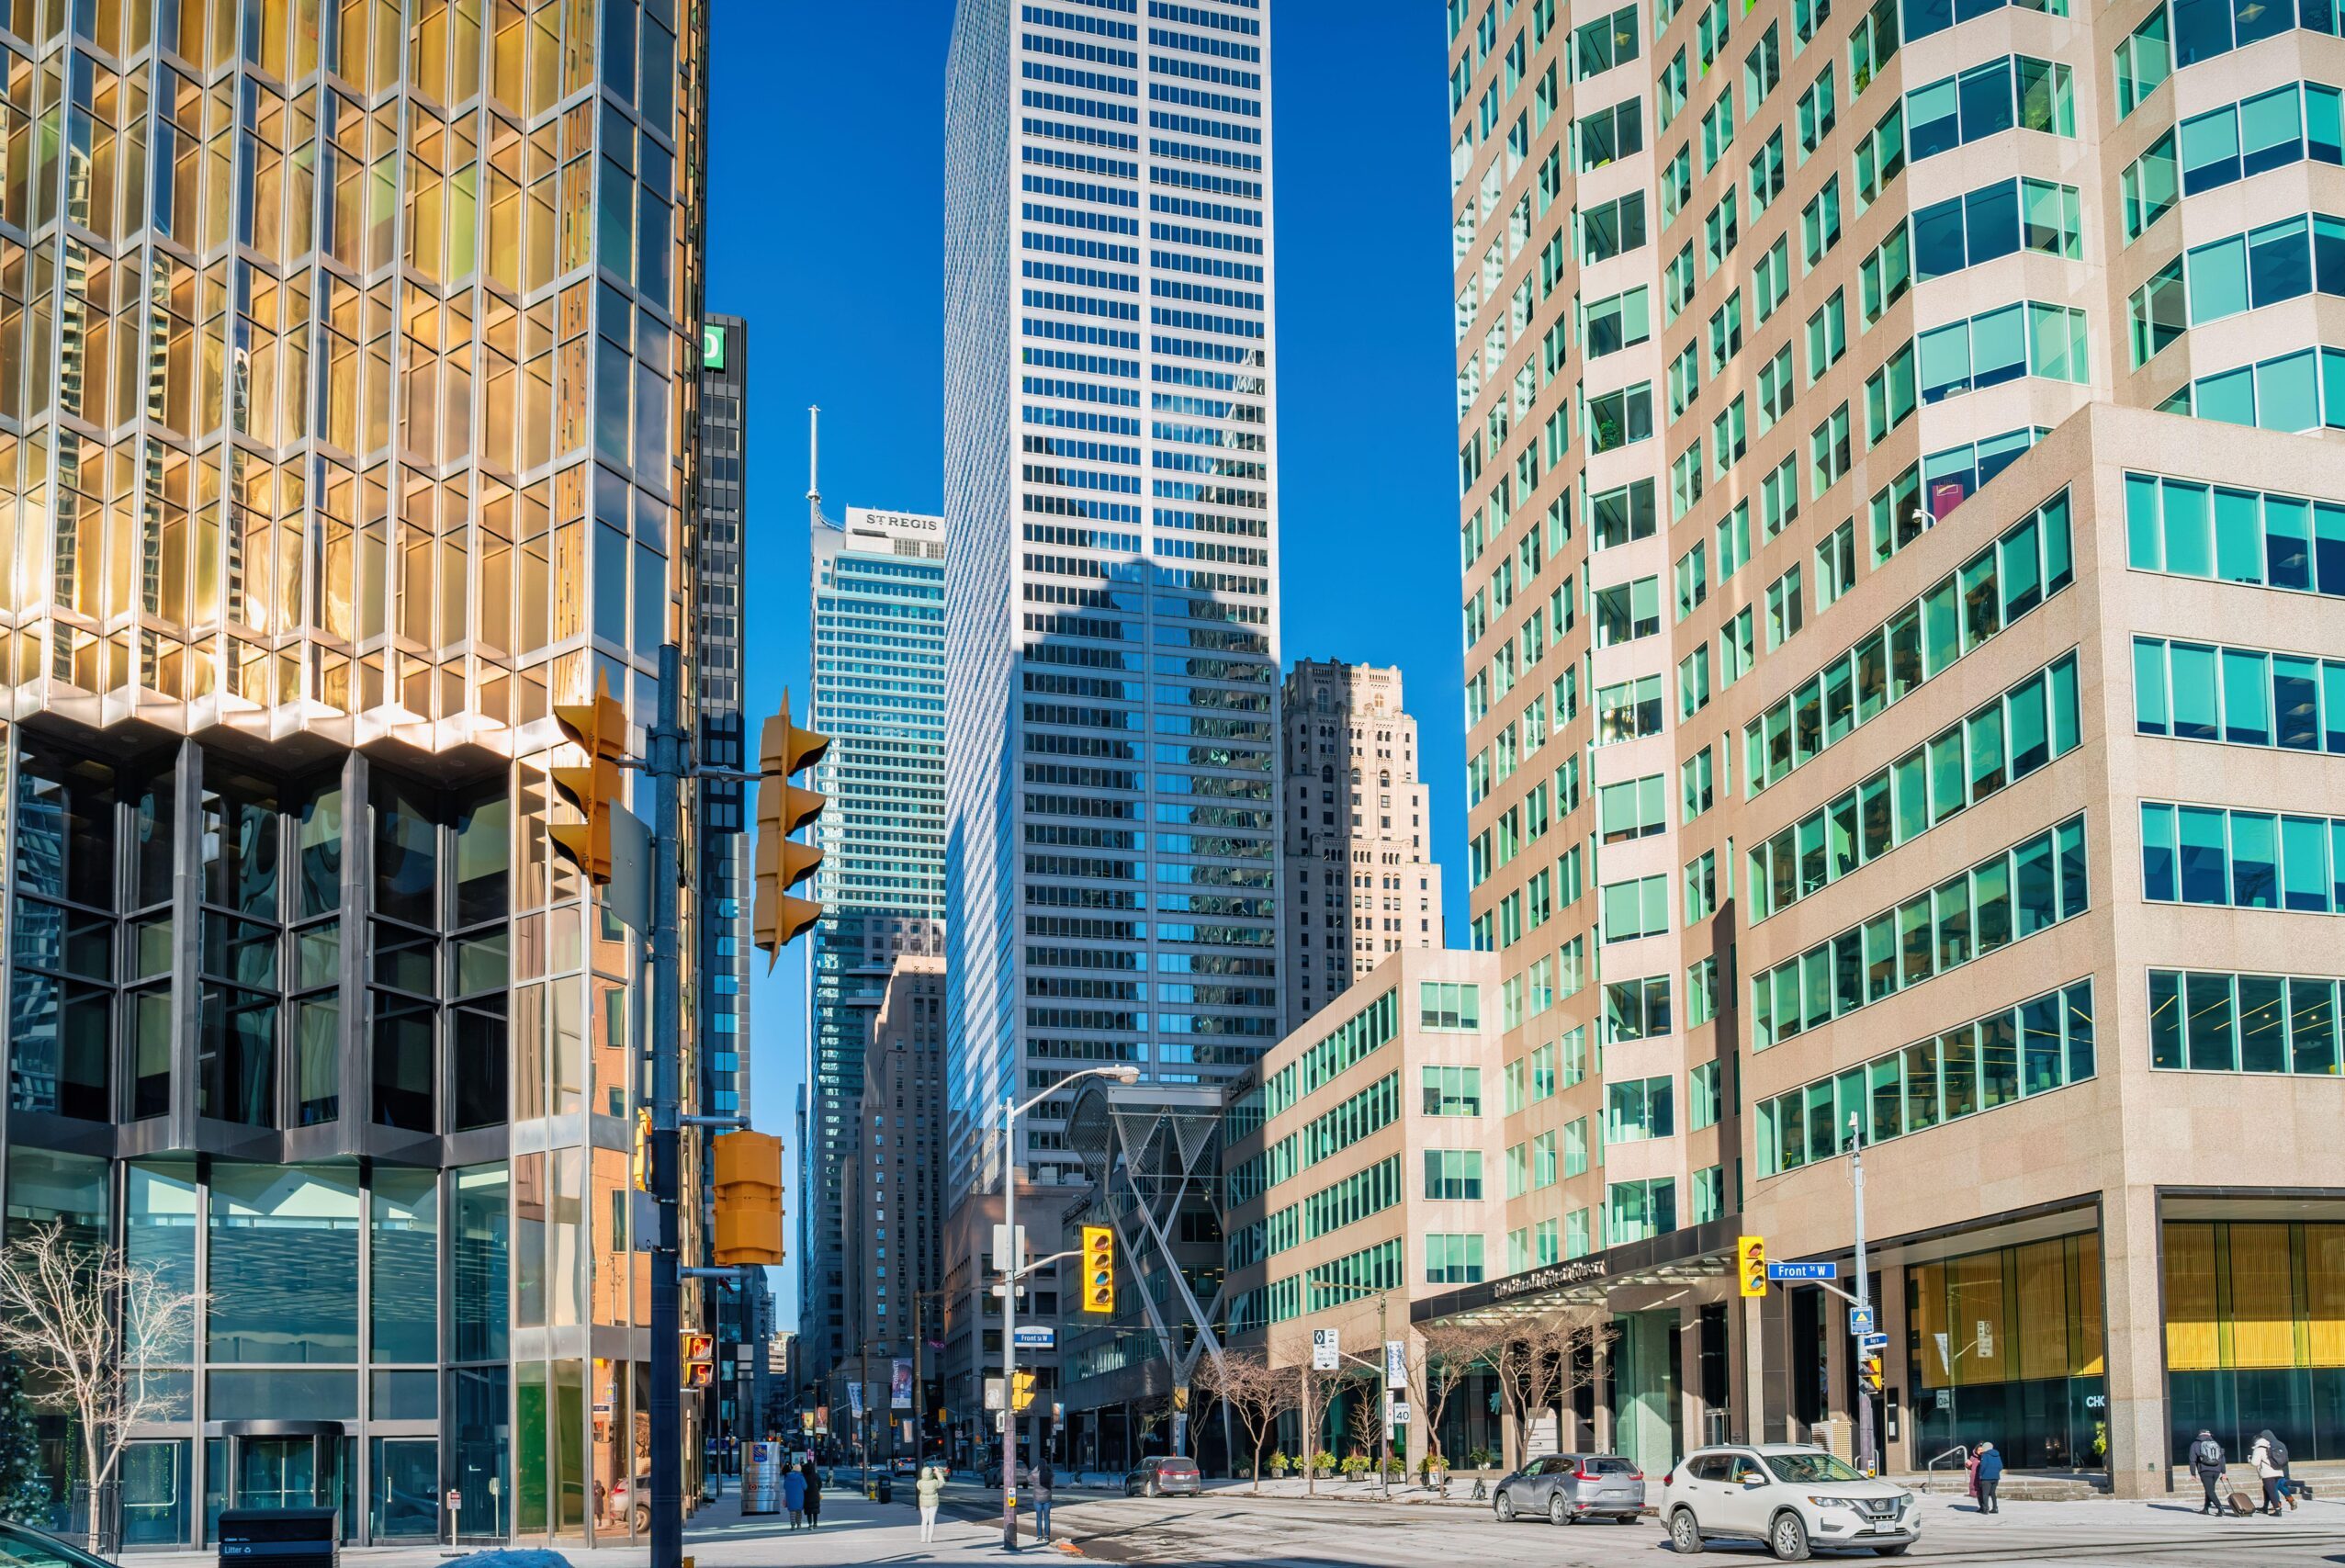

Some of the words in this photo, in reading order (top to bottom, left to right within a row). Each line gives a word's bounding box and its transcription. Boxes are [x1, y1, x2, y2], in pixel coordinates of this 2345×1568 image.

[888, 515, 937, 531] REGIS
[1778, 1266, 1807, 1276] Front
[1817, 1266, 1826, 1276] W
[697, 1366, 706, 1384] 5
[1396, 1411, 1409, 1421] 40
[224, 1546, 242, 1554] Litter
